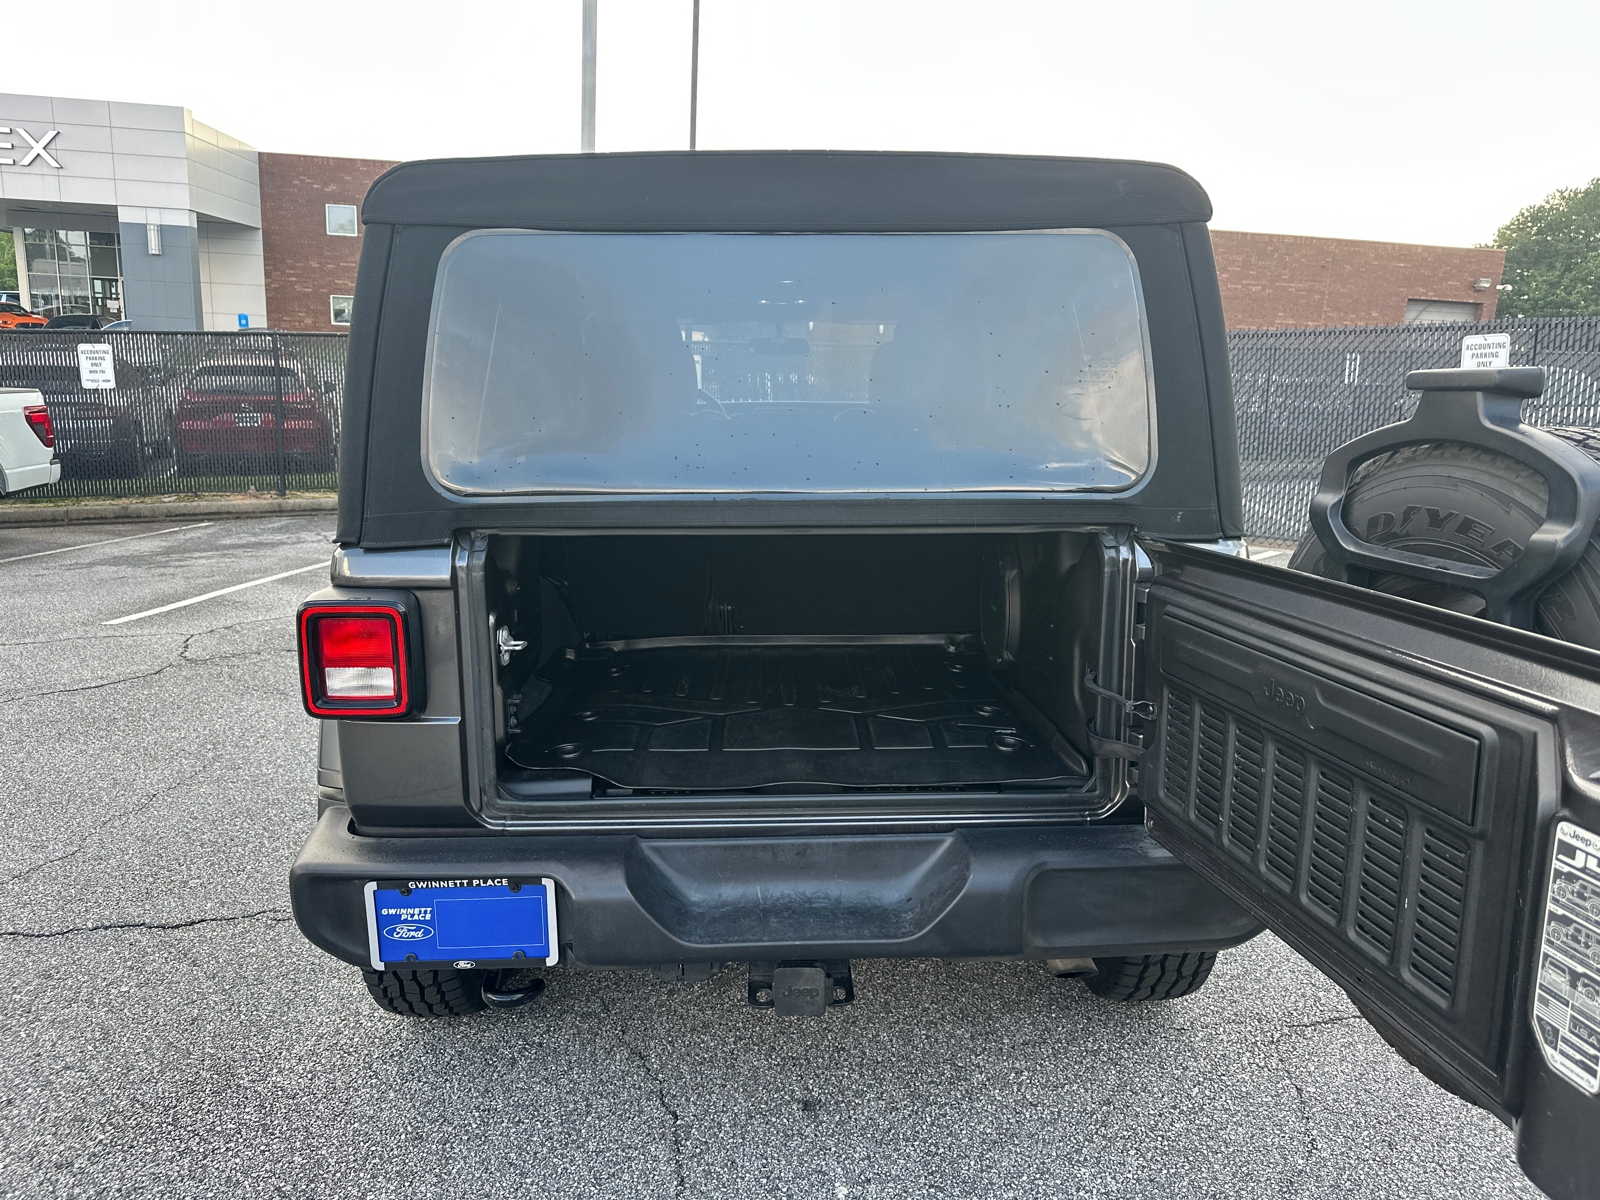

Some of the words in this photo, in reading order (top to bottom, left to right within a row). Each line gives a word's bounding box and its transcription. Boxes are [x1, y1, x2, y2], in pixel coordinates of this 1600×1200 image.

[1466, 341, 1507, 351] ACCOUNTING
[1471, 351, 1499, 360] PARKING
[1476, 360, 1493, 368] ONLY
[1262, 677, 1306, 718] Jeep
[1569, 829, 1592, 847] Jeep
[408, 880, 469, 889] GWINNETT
[472, 878, 509, 887] PLACE
[381, 907, 433, 915] GWINNETT
[400, 913, 432, 921] PLACE
[393, 925, 425, 938] Ford
[781, 984, 820, 1000] Jeep
